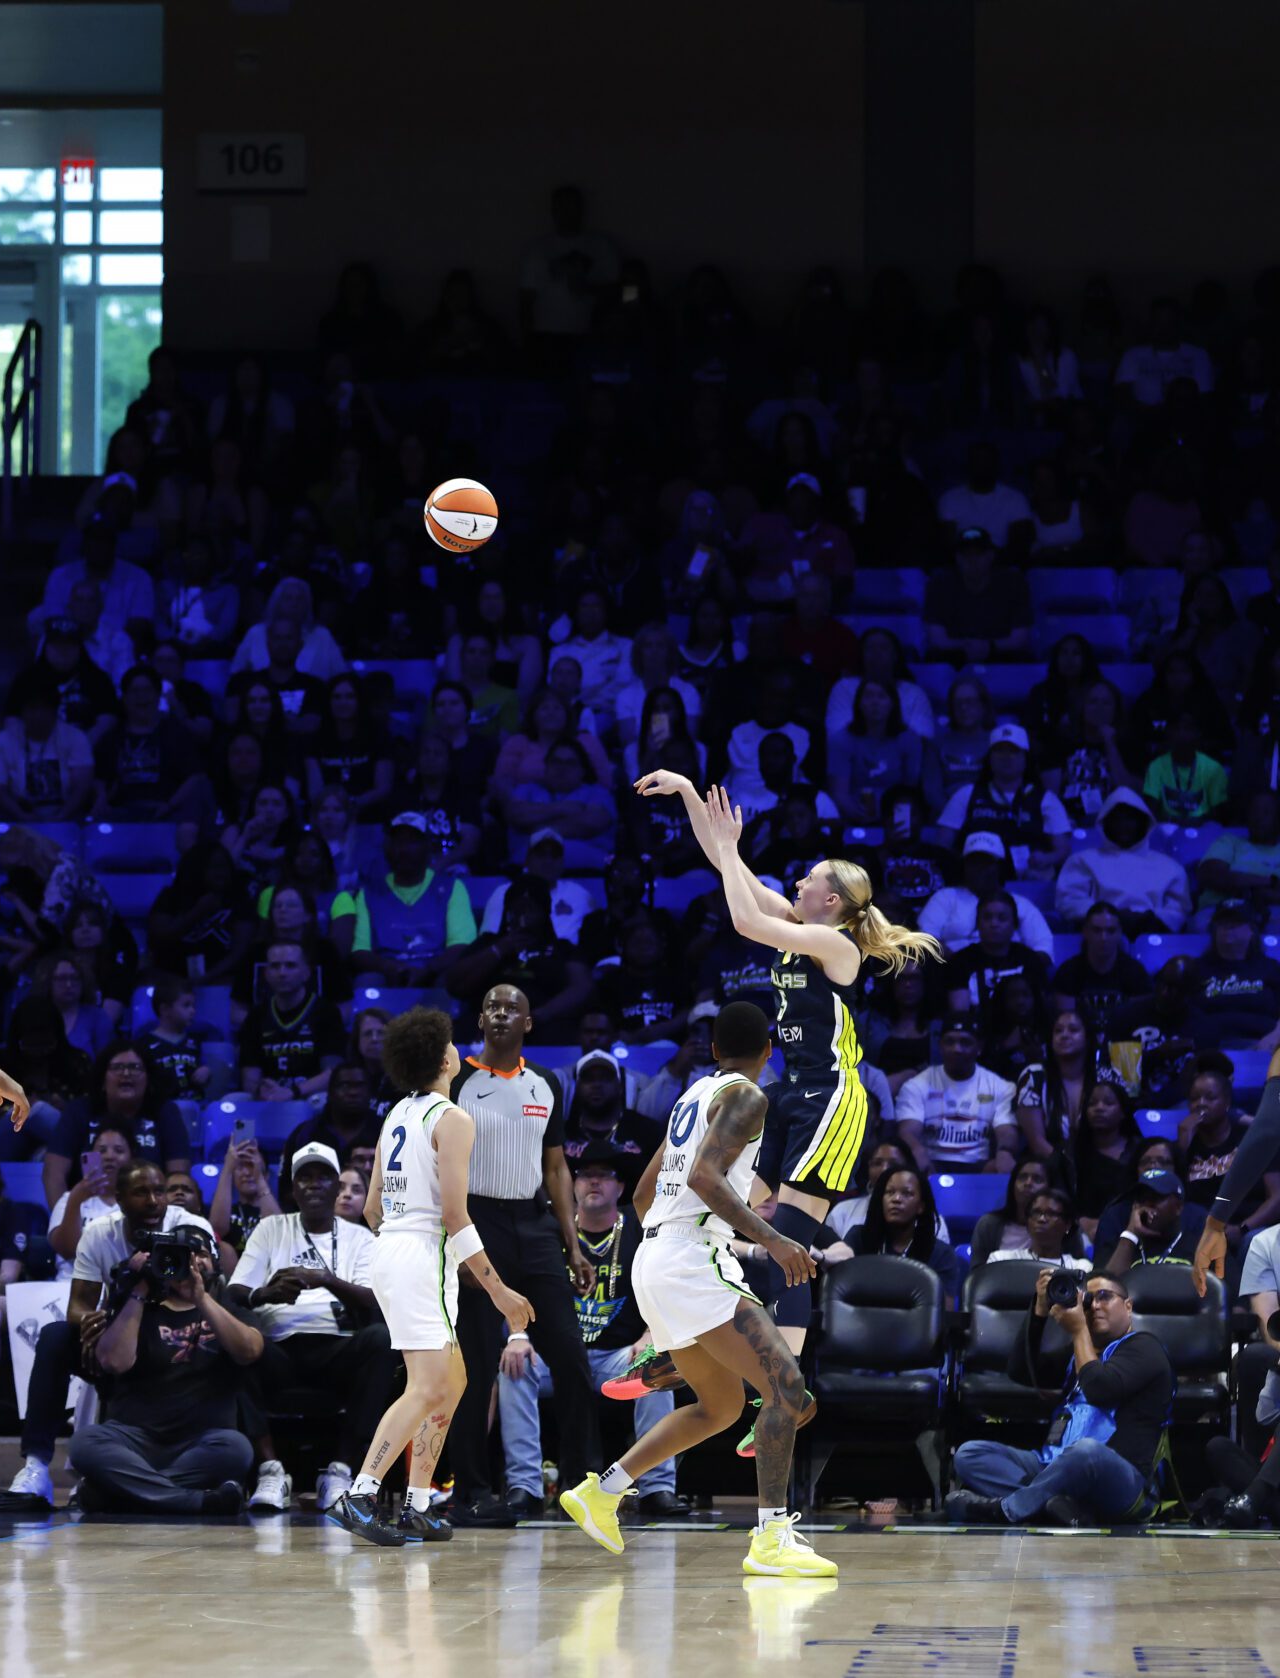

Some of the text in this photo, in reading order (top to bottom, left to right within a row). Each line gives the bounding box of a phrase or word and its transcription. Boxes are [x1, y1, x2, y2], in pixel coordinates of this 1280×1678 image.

[220, 143, 285, 176] 106
[770, 967, 808, 989] LLAS
[386, 1125, 407, 1172] 2
[660, 1153, 687, 1173] ILLIAMS
[383, 1176, 408, 1193] EDEMAN
[369, 1440, 391, 1472] BELIEVE
